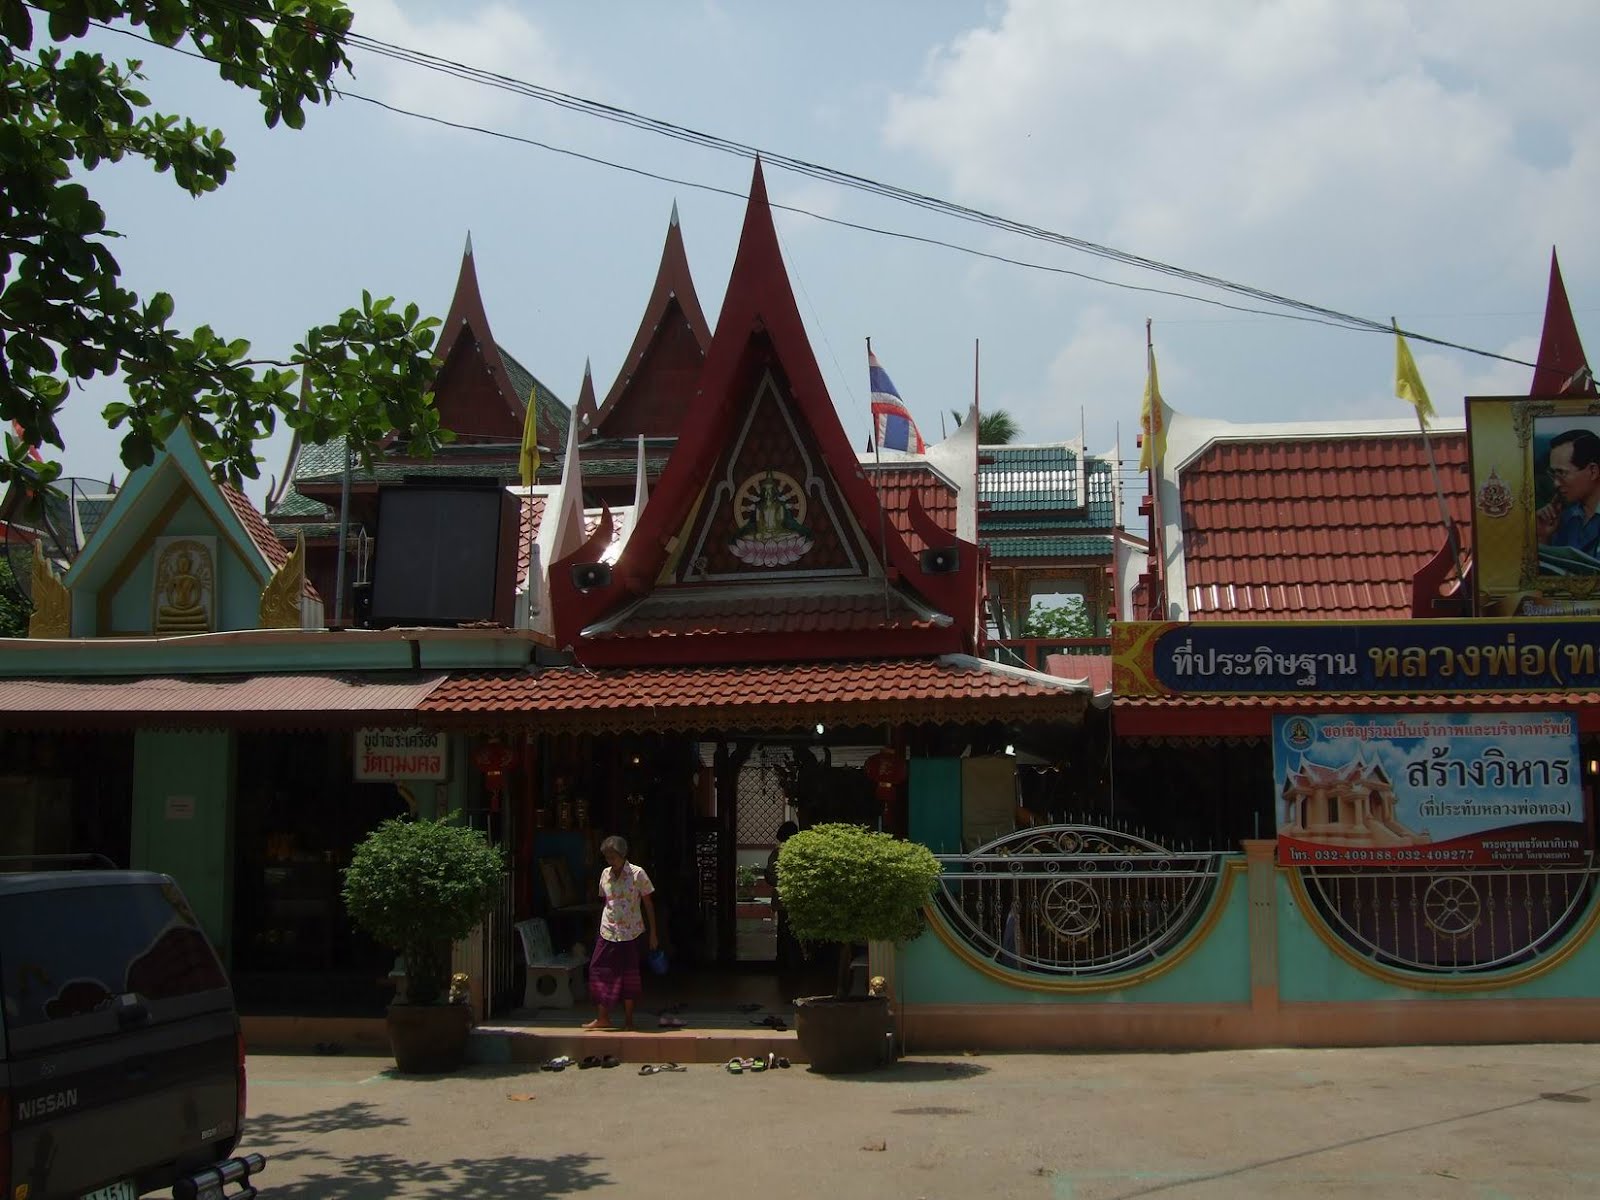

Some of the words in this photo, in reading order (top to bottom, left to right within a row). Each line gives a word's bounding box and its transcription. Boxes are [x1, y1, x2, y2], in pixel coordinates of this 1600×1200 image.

[1171, 638, 1358, 686] ที่ประดิษฐาน
[1368, 633, 1600, 685] หลวงพ่อ(ท
[1406, 746, 1570, 787] สร้างวิหาร
[1419, 797, 1572, 817] (ที่ประทับหลวงพ่อทอง)
[18, 1088, 78, 1121] NISSAN
